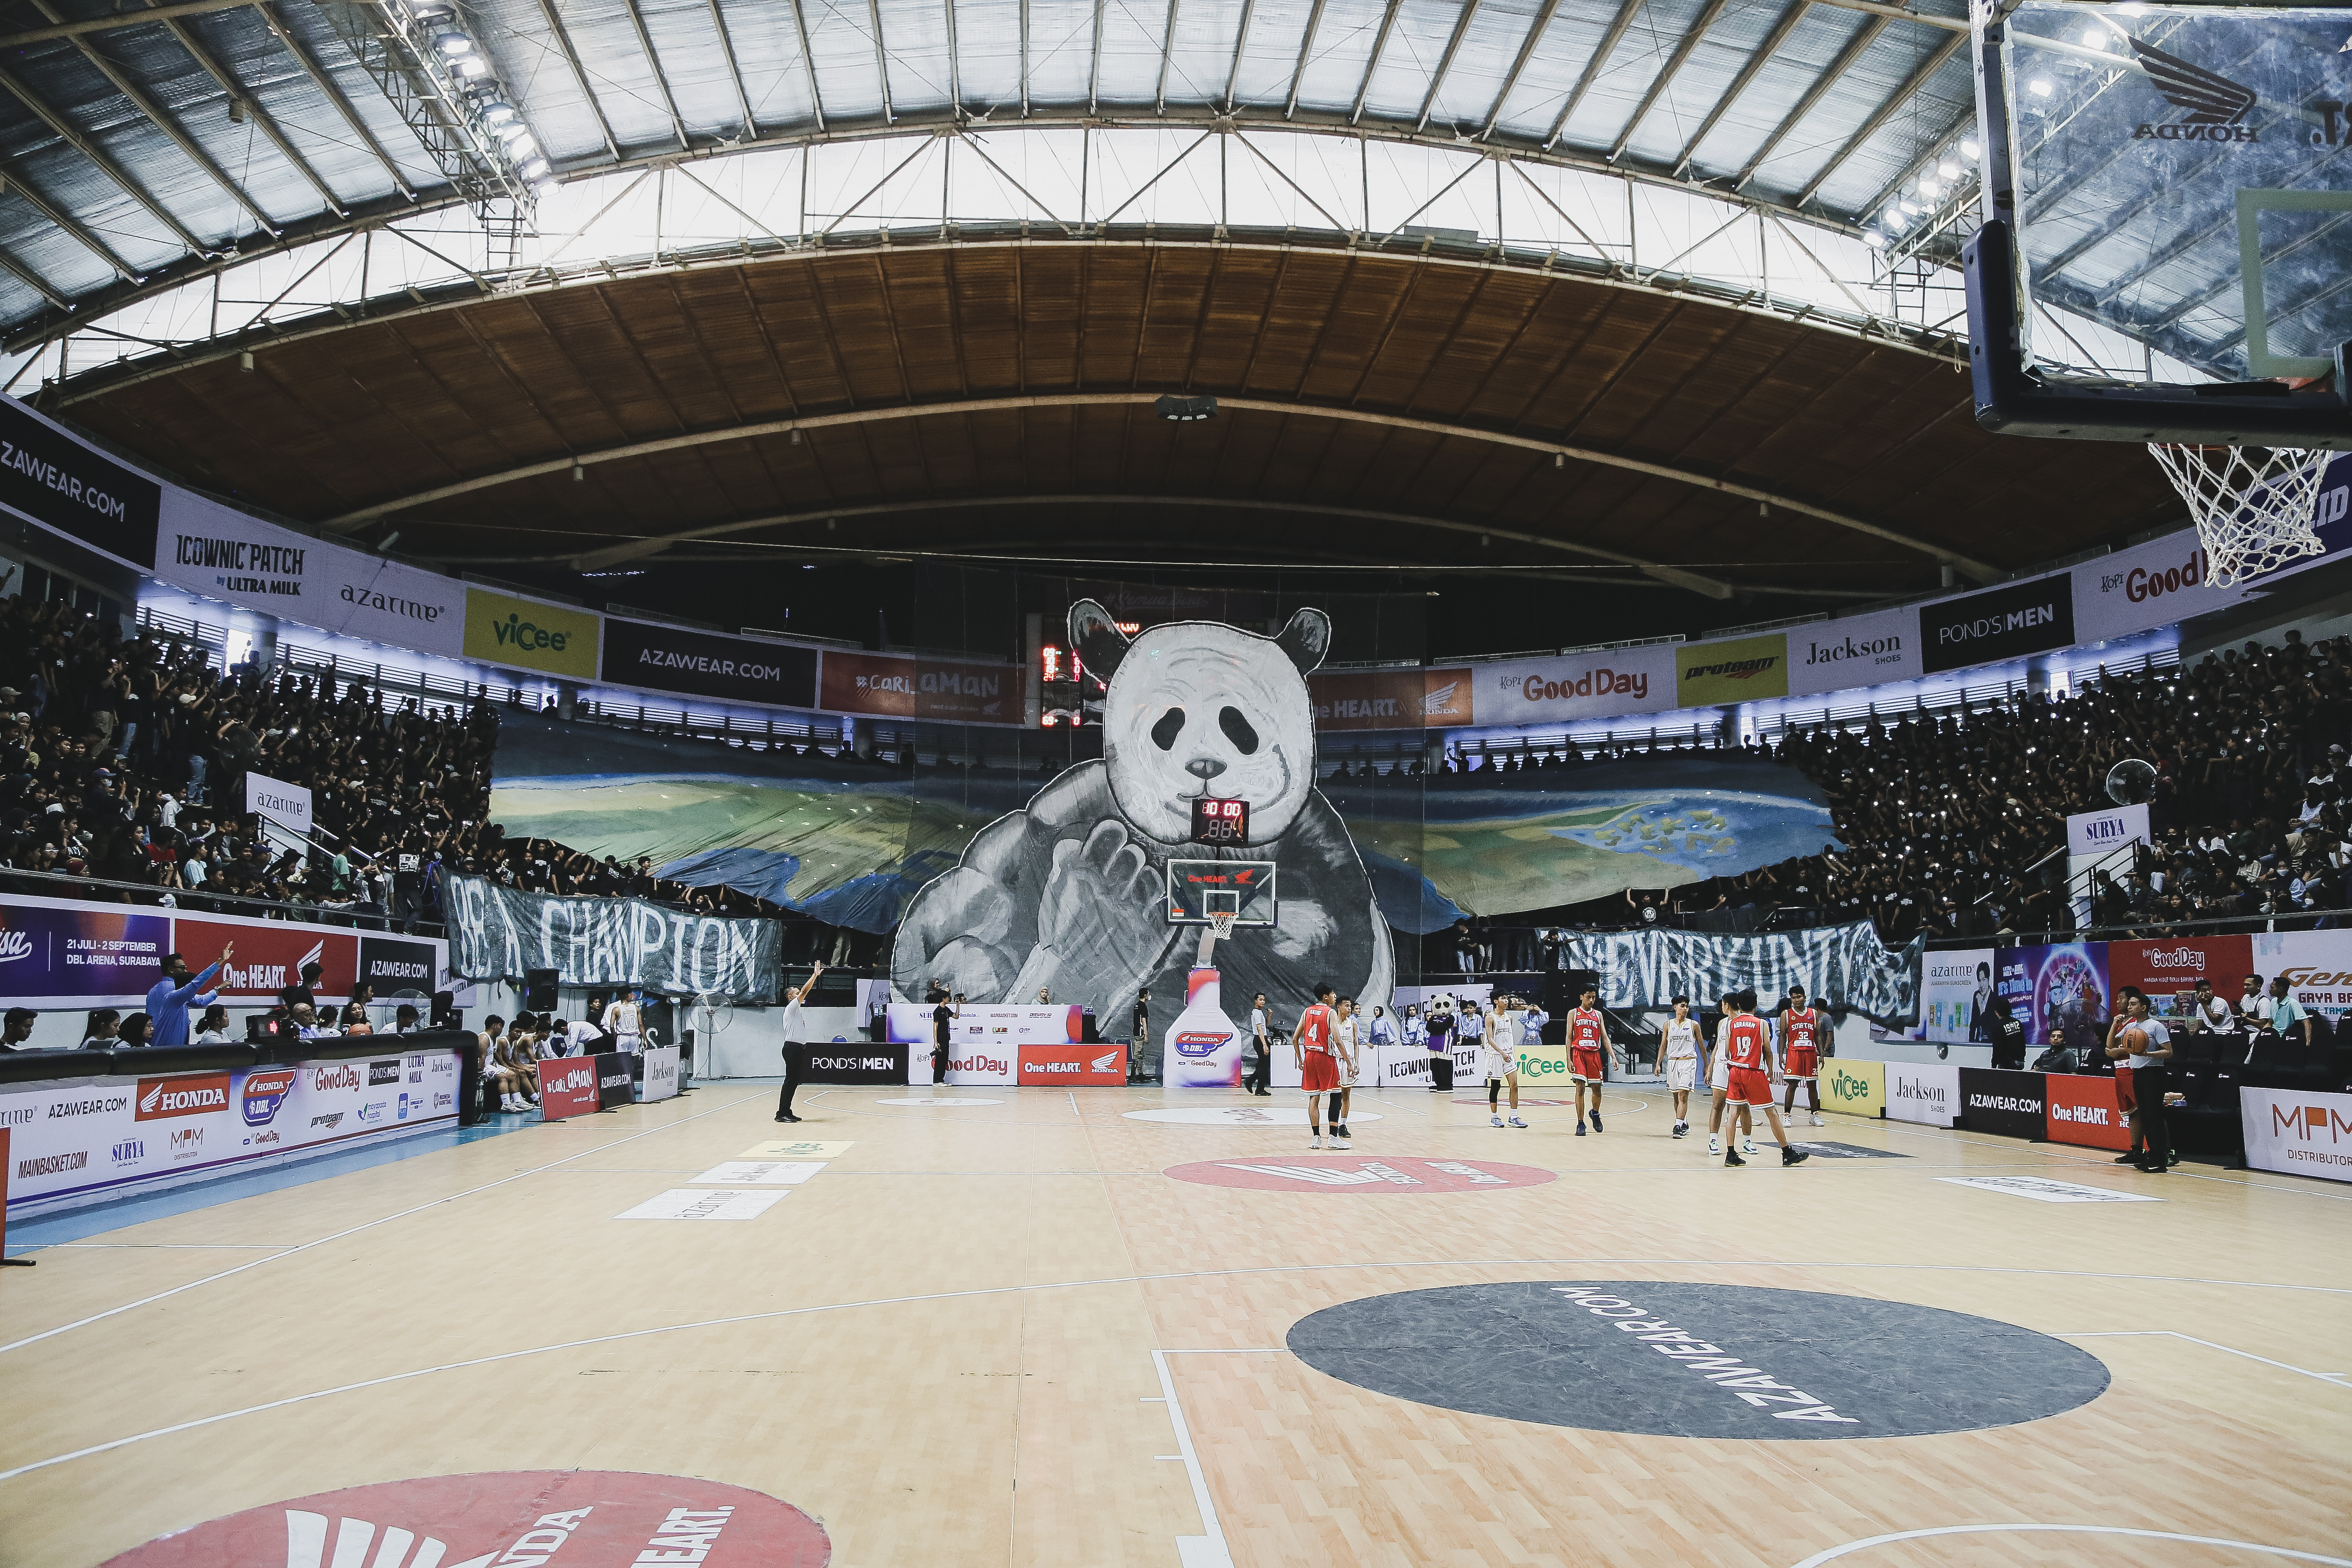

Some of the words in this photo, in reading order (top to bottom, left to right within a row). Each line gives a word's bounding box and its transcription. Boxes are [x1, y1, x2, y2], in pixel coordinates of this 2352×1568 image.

[249, 544, 306, 575] PATCH
[227, 576, 266, 593] ULTRA
[269, 580, 301, 596] MILK
[340, 584, 438, 623] azarine
[1940, 616, 2002, 644] POND'S
[2008, 604, 2054, 631] MEN
[1807, 636, 1902, 665] Jackson
[1875, 654, 1901, 665] SHOES
[639, 649, 780, 681] AZAWEAR.COM
[1685, 656, 1776, 680] proteam
[1044, 673, 1054, 681] 24
[1313, 705, 1330, 719] ne
[1334, 698, 1399, 718] HEART.
[1042, 716, 1054, 725] 69
[1074, 716, 1080, 725] 0
[2086, 818, 2125, 841] SURYA
[67, 939, 76, 949] 21
[77, 940, 96, 949] JULI
[102, 940, 107, 949] 2
[108, 941, 156, 952] SEPTEMBER
[67, 954, 85, 964] DBL
[86, 955, 118, 966] ARENA,
[119, 956, 161, 966] SURABAYA
[371, 960, 428, 978] AZAWEAR.COM
[223, 963, 247, 988] One
[248, 964, 287, 989] HEART.
[297, 980, 323, 989] HDA
[2298, 992, 2333, 1003] GAYA
[624, 1014, 637, 1029] 10
[1733, 1021, 1756, 1029] ABRAHAM
[1308, 1023, 1318, 1042] 4
[1798, 1032, 1809, 1040] 32
[408, 1055, 425, 1068] ULTRA
[432, 1059, 453, 1072] Jackson
[812, 1057, 857, 1070] POND'S
[862, 1057, 894, 1070] MEN
[1025, 1062, 1045, 1073] One
[1046, 1063, 1081, 1073] HEART.
[1389, 1058, 1430, 1078] ICOWNI
[387, 1065, 400, 1077] MEN
[408, 1070, 423, 1084] MILK
[652, 1061, 674, 1081] Jackson
[1454, 1068, 1475, 1078] MILK
[256, 1081, 285, 1092] HONDA
[601, 1074, 631, 1089] AZAWEAR.COM
[1896, 1076, 1945, 1102] Jackson
[48, 1097, 128, 1119] AZAWEAR.COM
[160, 1088, 227, 1111] HONDA
[1969, 1093, 2042, 1114] AZAWEAR.COM
[255, 1104, 270, 1115] DBL
[1930, 1105, 1945, 1113] SHOES
[2052, 1103, 2073, 1121] One
[2073, 1105, 2109, 1126] HEART.
[310, 1112, 344, 1128] proteam
[171, 1127, 204, 1150] MPM
[112, 1140, 144, 1162] SURYA
[174, 1151, 198, 1161] DISTRIBUTOR
[18, 1151, 89, 1179] MAINBASKET.COM
[721, 1163, 780, 1181] Jackson
[1358, 1161, 1425, 1185] HONDA
[1549, 1286, 1862, 1424] AZAWEAR.COM
